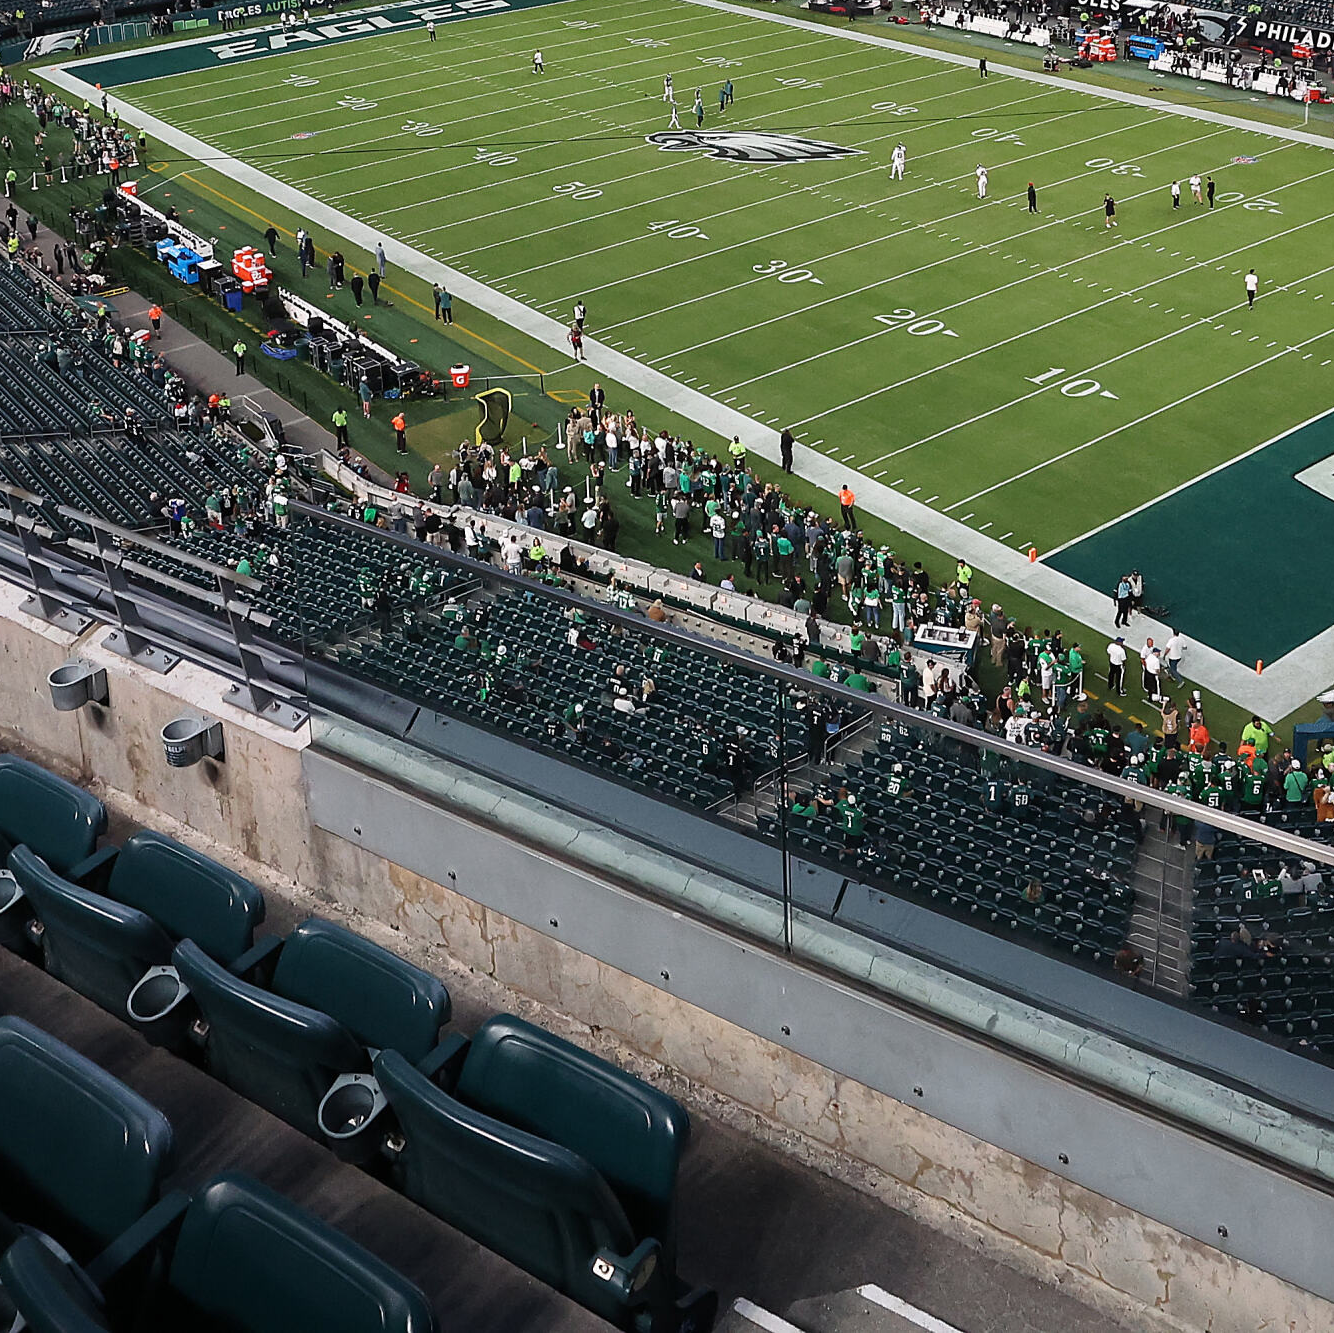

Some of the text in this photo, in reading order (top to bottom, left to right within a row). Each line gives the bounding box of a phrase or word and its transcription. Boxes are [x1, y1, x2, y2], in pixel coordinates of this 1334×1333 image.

[342, 96, 378, 112] 20
[407, 120, 444, 137] 30
[477, 147, 519, 167] 40
[553, 181, 604, 201] 50
[647, 219, 701, 240] 40
[752, 259, 813, 284] 30
[874, 307, 947, 337] 20
[1025, 366, 1101, 400] 10
[887, 782, 900, 795] 20
[989, 785, 996, 801] 1
[1253, 784, 1261, 795] 6
